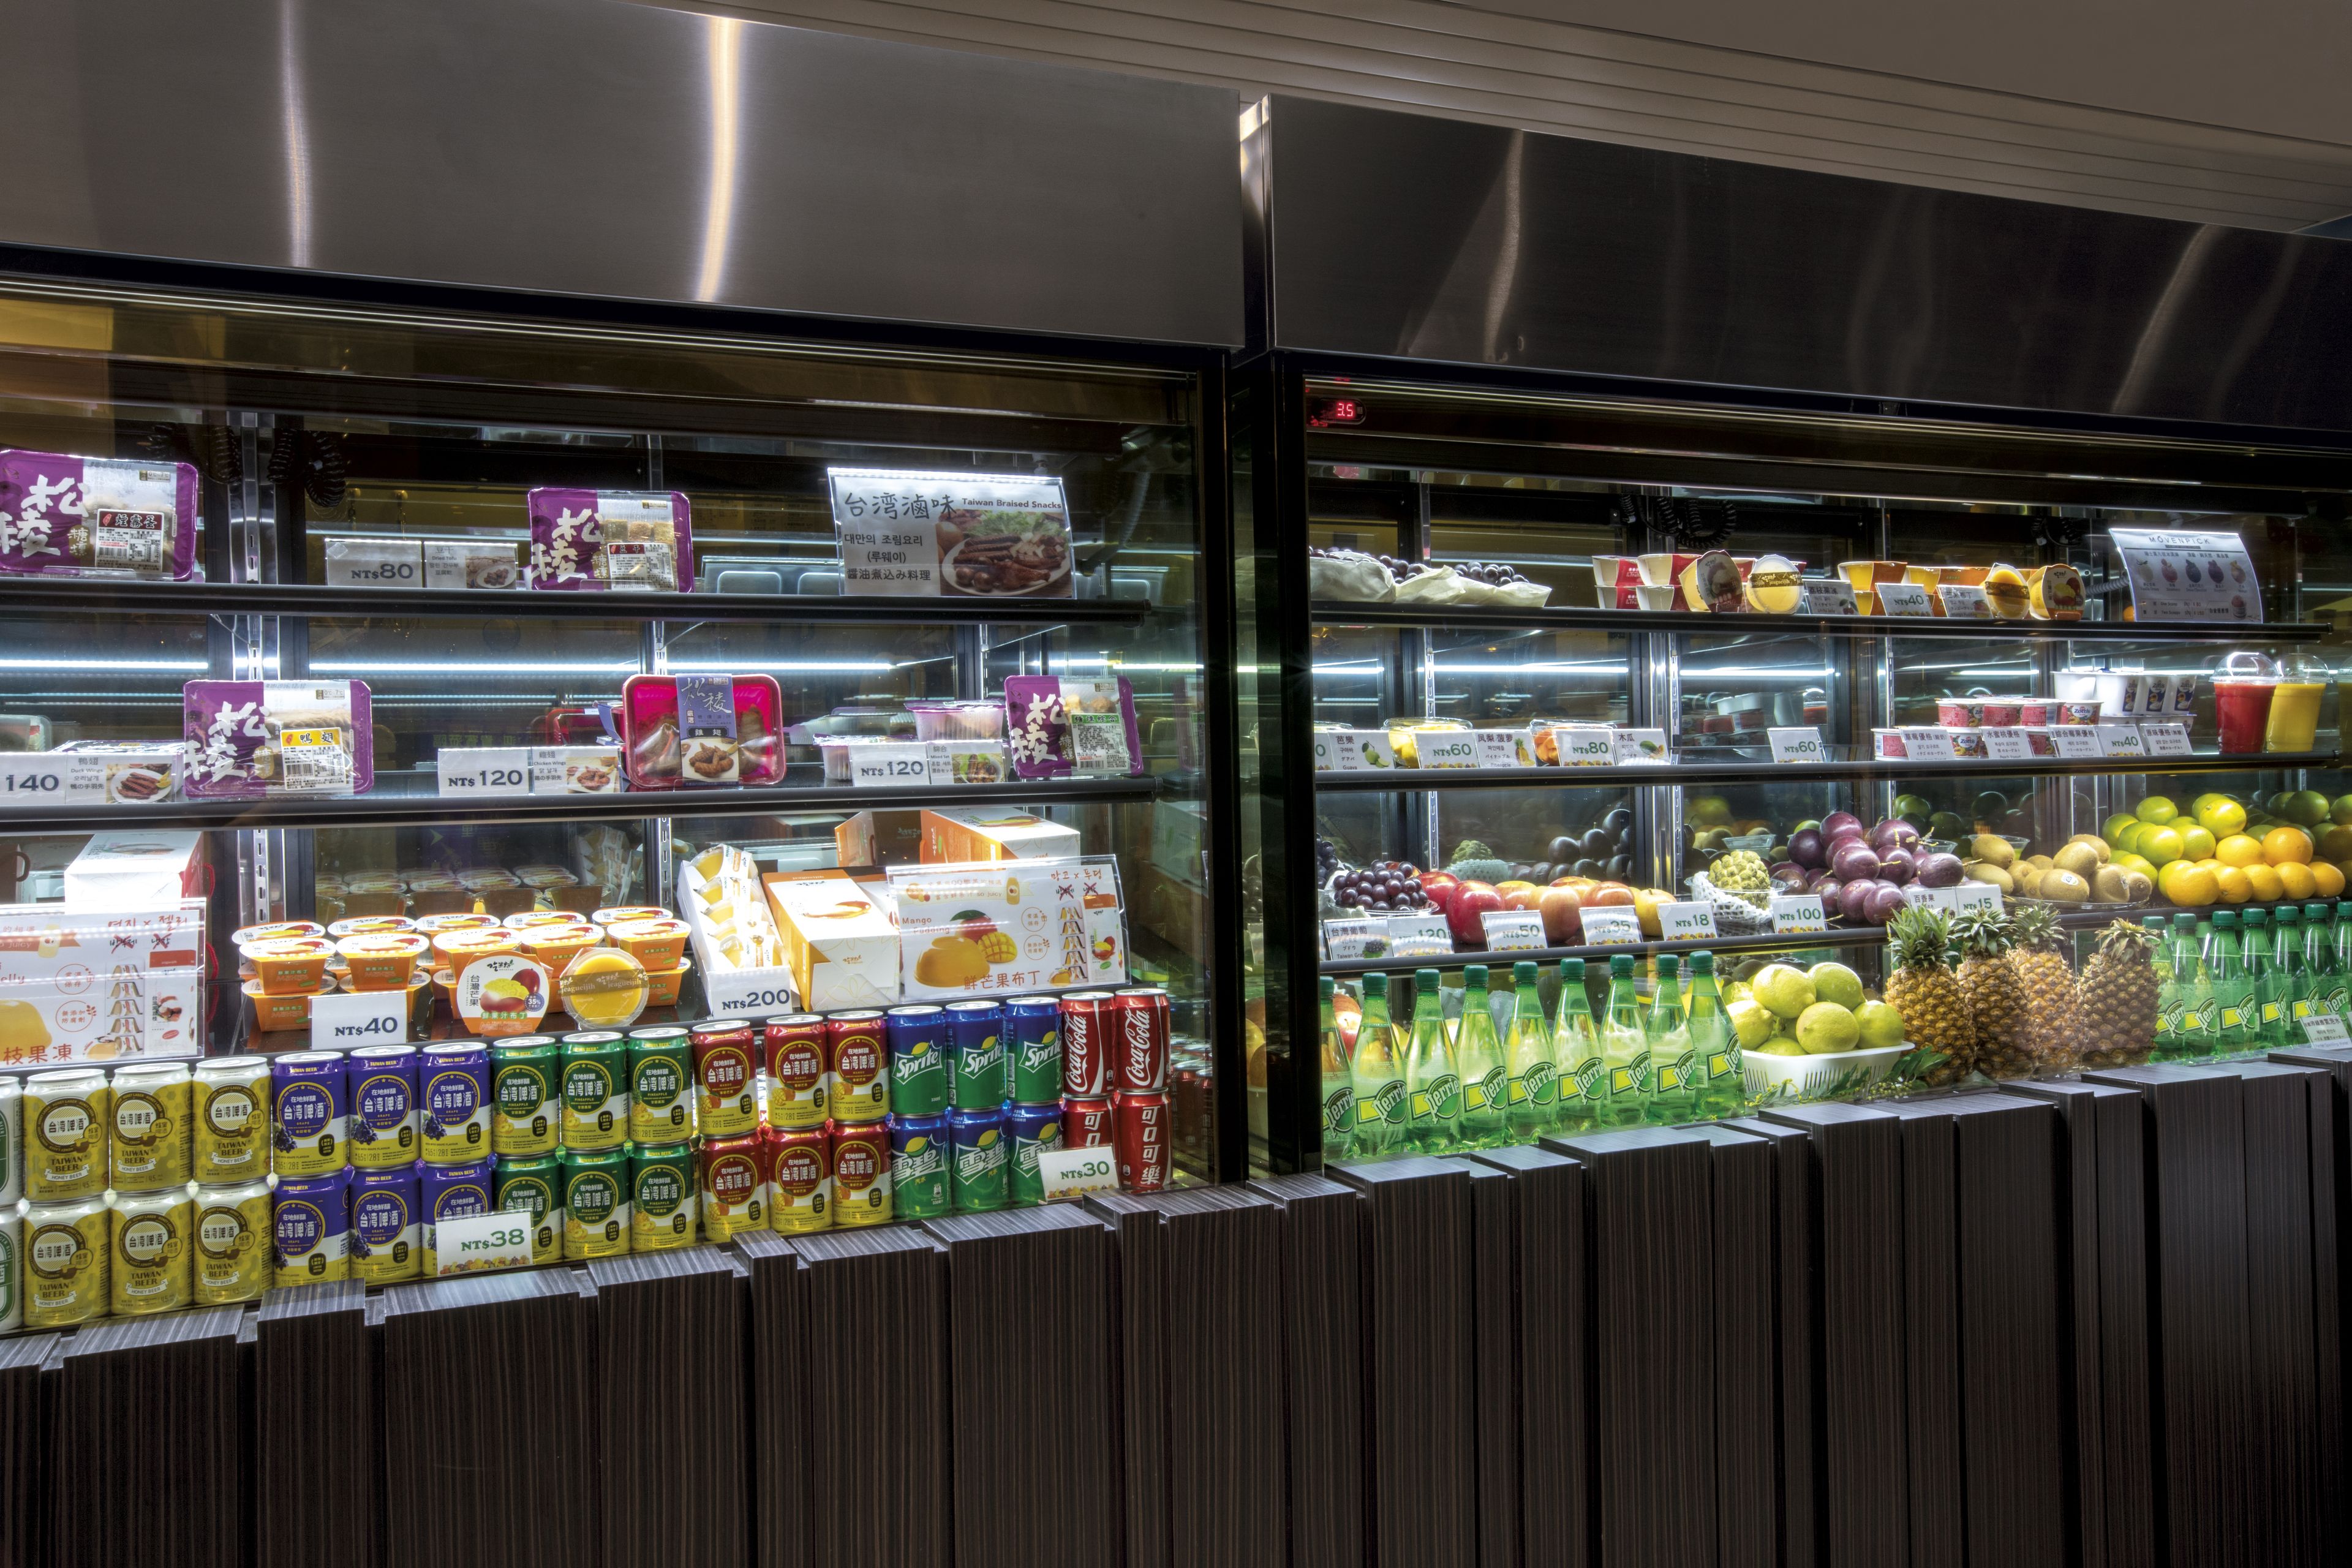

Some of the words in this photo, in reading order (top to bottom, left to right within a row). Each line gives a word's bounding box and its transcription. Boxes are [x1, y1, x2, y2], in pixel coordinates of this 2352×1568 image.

[962, 497, 993, 507] Taiwan
[996, 499, 1030, 508] Braised
[1031, 500, 1063, 510] Snacks
[844, 533, 876, 545] 대만의
[881, 534, 924, 547] 조림요리
[867, 551, 907, 564] (루웨이)
[1784, 741, 1817, 753] NT$60
[2111, 736, 2139, 747] NT$40
[1433, 744, 1472, 756] NT$60
[1572, 742, 1609, 754] NT$80
[1913, 894, 1936, 903] 百香果
[902, 917, 932, 926] Mango
[913, 926, 950, 935] Pudding
[1502, 924, 1540, 940] NT$50
[1, 974, 26, 984] elly
[963, 970, 1041, 991] 鮮芒果布丁
[722, 989, 790, 1011] NT$200
[334, 1017, 398, 1037] NT$40
[966, 1040, 1003, 1073] Sprite
[1025, 1040, 1063, 1072] Sprite
[897, 1051, 940, 1078] Sprite
[1142, 1106, 1162, 1185] 可口可樂
[122, 1149, 150, 1158] TAIWAN
[50, 1156, 83, 1166] TAIWAN
[55, 1163, 80, 1172] BEER
[1060, 1161, 1110, 1180] NT$30
[461, 1228, 526, 1253] NT$38
[206, 1262, 233, 1270] TAIWAN
[130, 1269, 162, 1280] TAIWAN
[39, 1282, 69, 1292] TAIWAN
[135, 1278, 157, 1287] BEER
[42, 1290, 65, 1299] BEER
